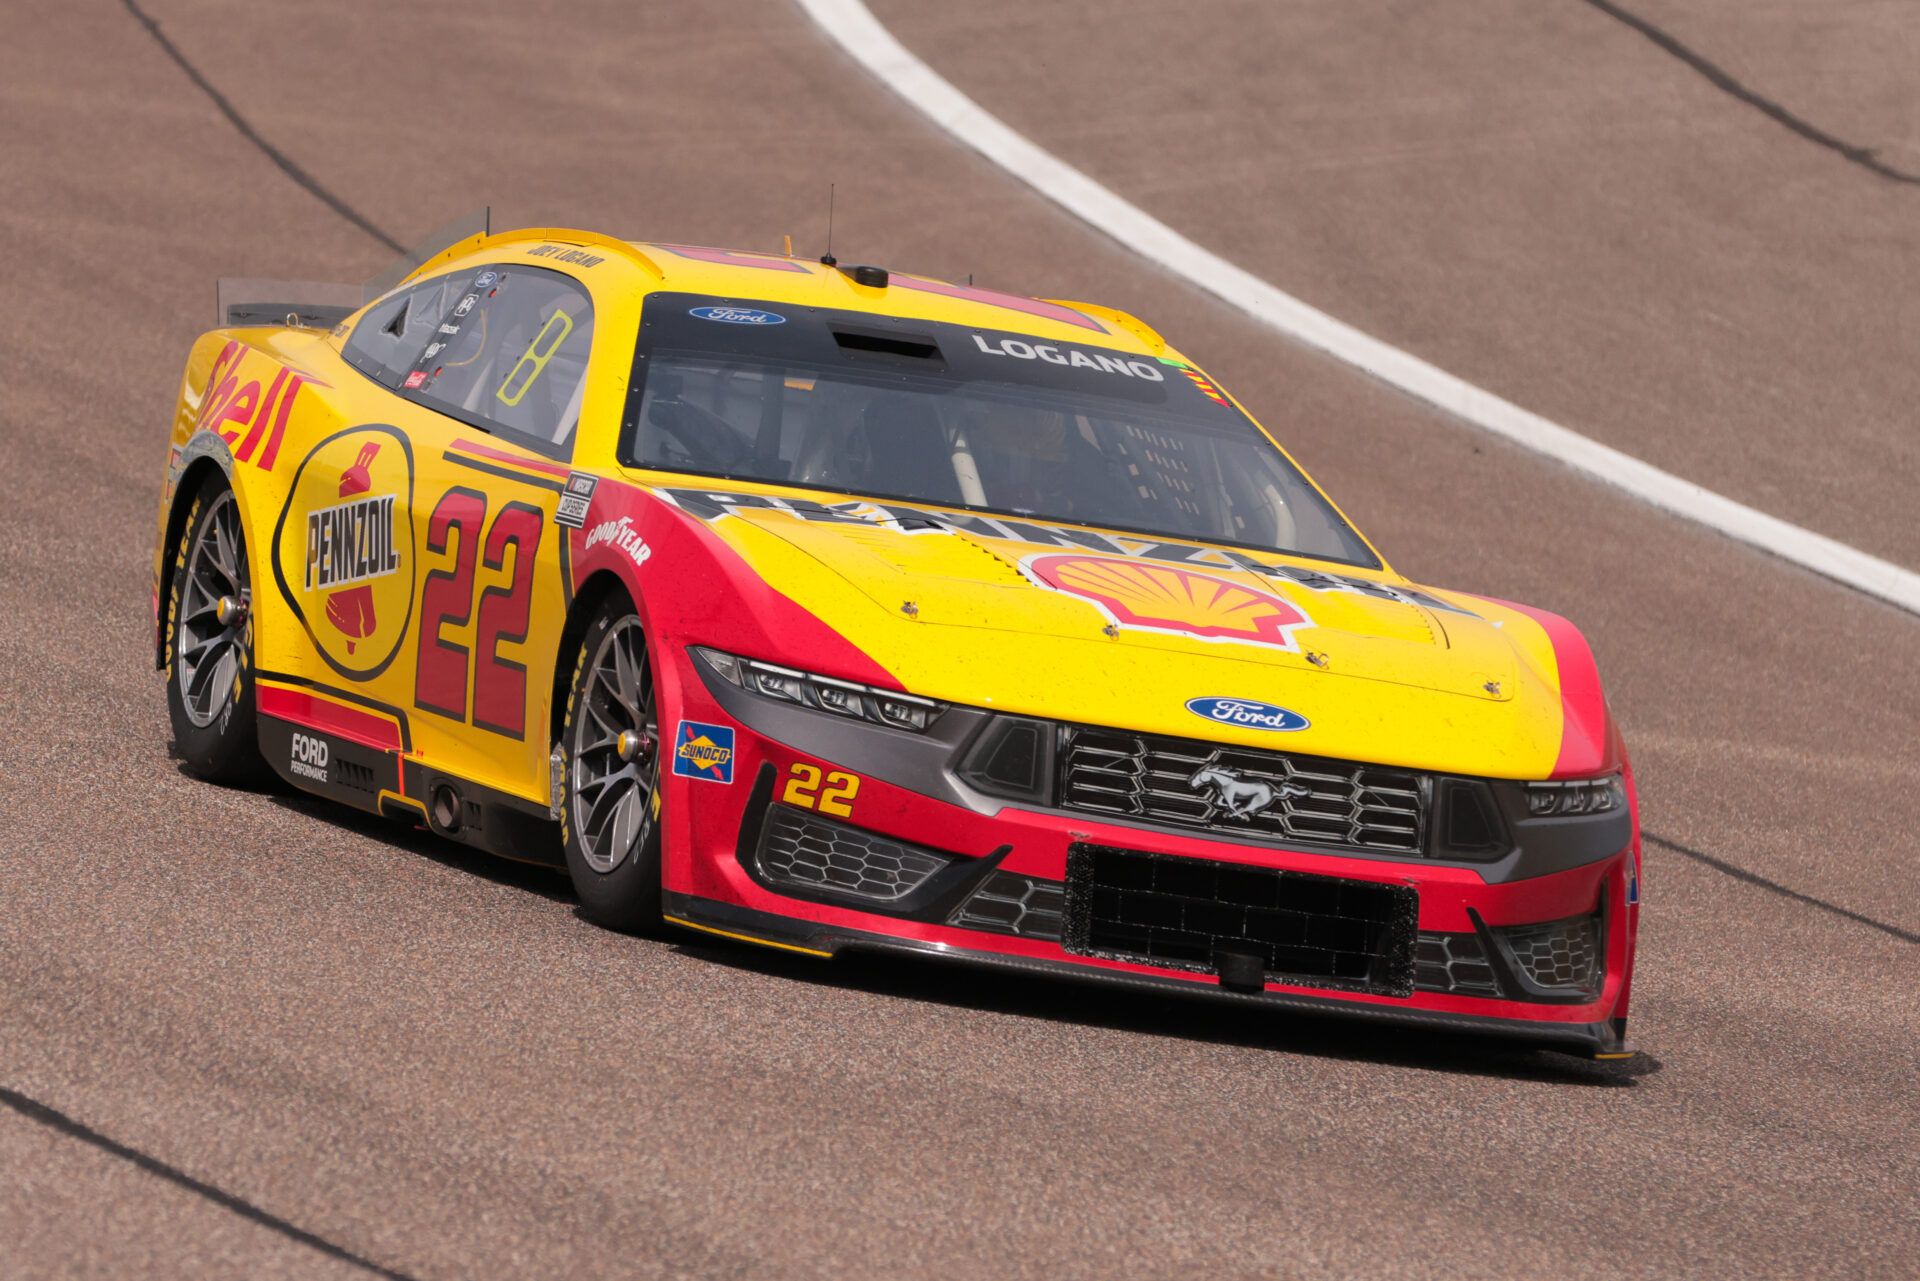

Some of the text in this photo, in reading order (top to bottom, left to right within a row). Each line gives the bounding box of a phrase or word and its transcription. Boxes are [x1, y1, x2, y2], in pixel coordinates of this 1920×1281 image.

[554, 249, 605, 268] LOGANO
[708, 308, 769, 323] Ford
[972, 335, 1164, 381] LOGANO
[196, 339, 304, 472] Shell
[304, 494, 401, 592] PENNZOIL
[585, 516, 652, 567] GOODYEAR
[414, 485, 543, 742] 22
[1212, 701, 1286, 727] Ford
[291, 732, 328, 767] FORD
[681, 744, 729, 763] SUNOCO
[290, 760, 328, 782] PERFORMANCE
[782, 762, 861, 818] 22
